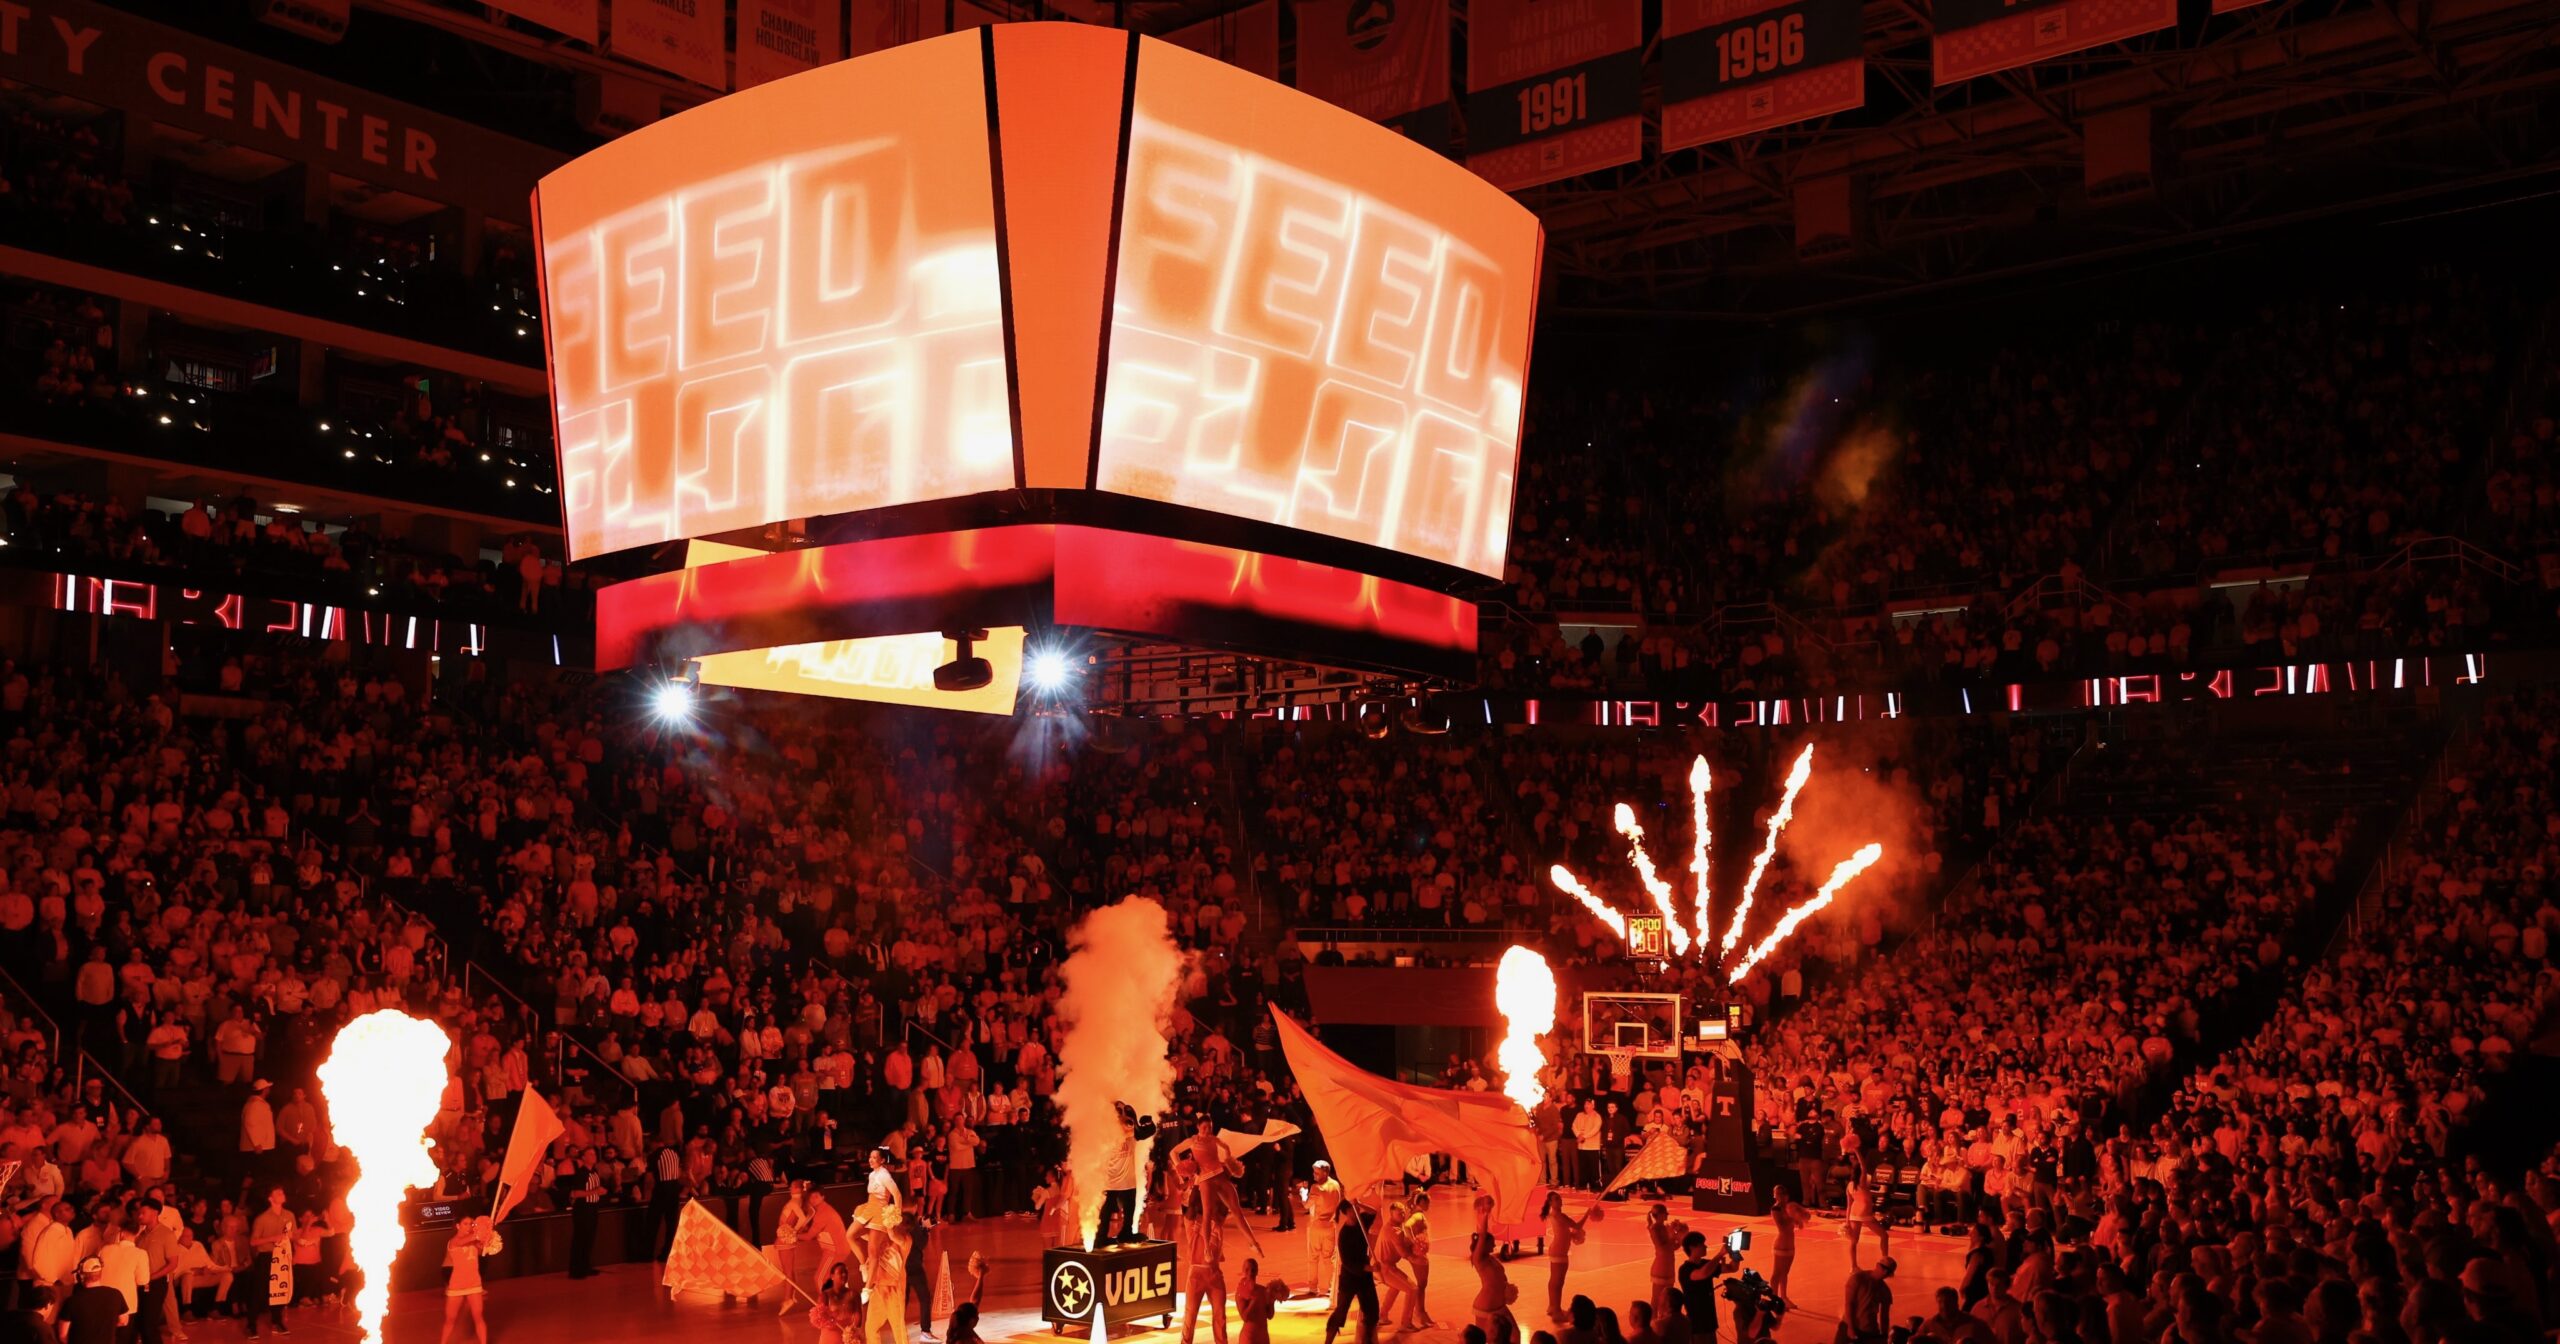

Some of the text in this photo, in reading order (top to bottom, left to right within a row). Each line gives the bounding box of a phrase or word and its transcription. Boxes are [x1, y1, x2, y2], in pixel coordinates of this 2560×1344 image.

[756, 27, 820, 67] HOLDSCLAW
[761, 10, 817, 46] CHAMIQUE
[1715, 12, 1804, 84] 1996
[146, 51, 439, 181] CENTER
[1517, 71, 1588, 135] 1991
[1631, 917, 1662, 931] 20:00
[1716, 1095, 1735, 1117] T
[1695, 1177, 1719, 1191] FOOD
[1732, 1180, 1752, 1193] CITY
[1105, 1261, 1172, 1307] VOLS
